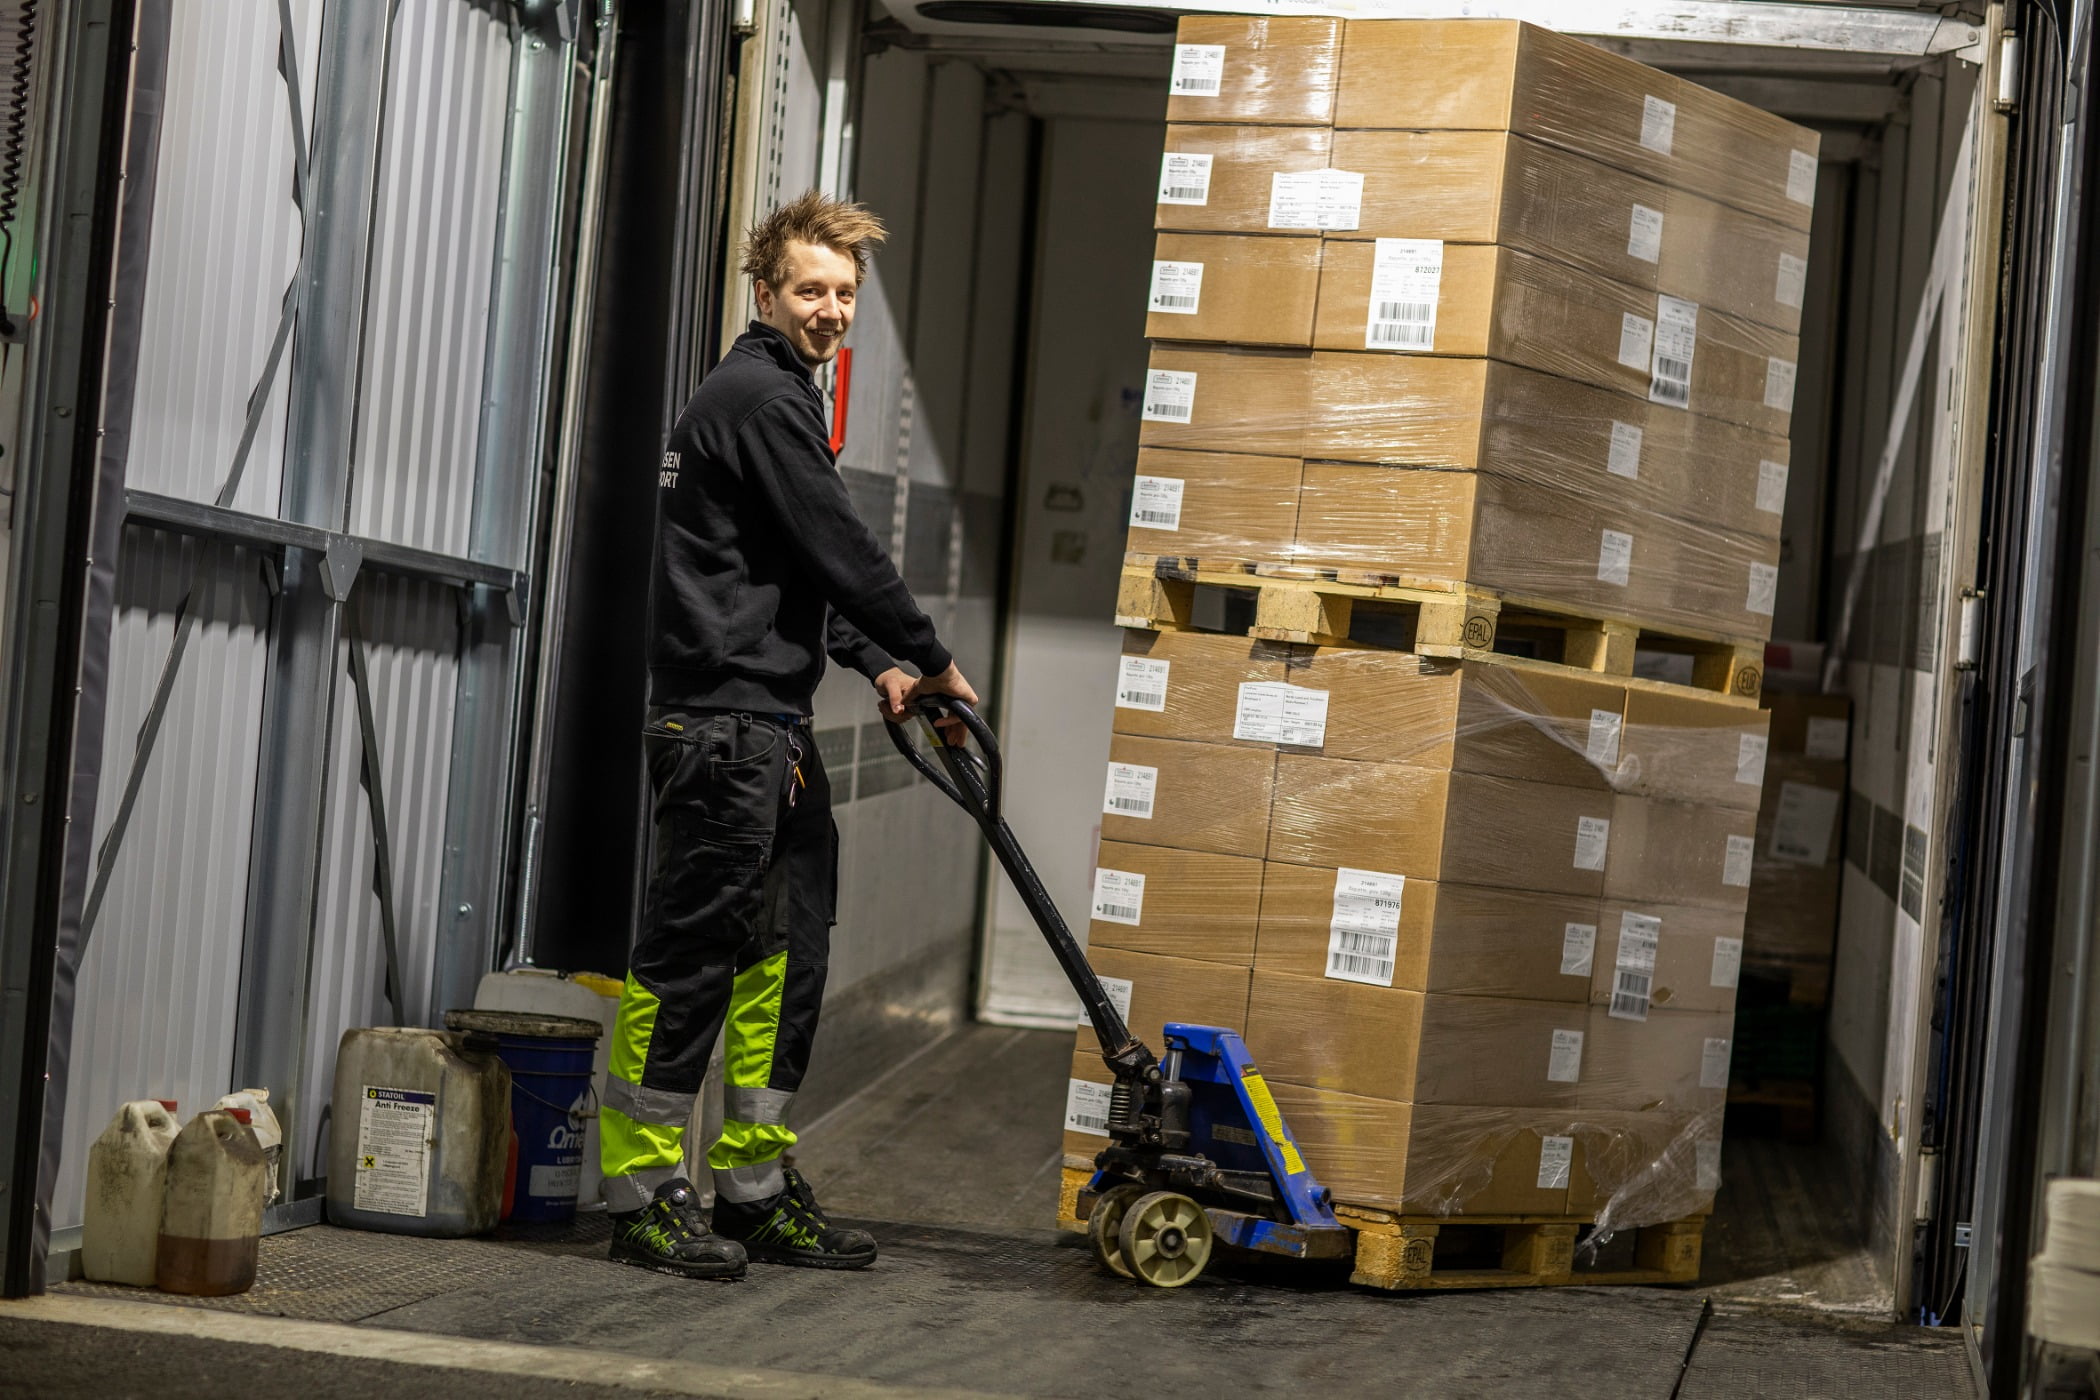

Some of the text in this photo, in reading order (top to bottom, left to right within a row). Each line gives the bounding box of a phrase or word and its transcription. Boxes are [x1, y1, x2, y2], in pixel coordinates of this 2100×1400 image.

[1467, 622, 1487, 642] EPAL
[1375, 899, 1400, 910] 871976
[378, 1091, 405, 1100] STATOIL
[375, 1101, 420, 1112] Anti Freeze
